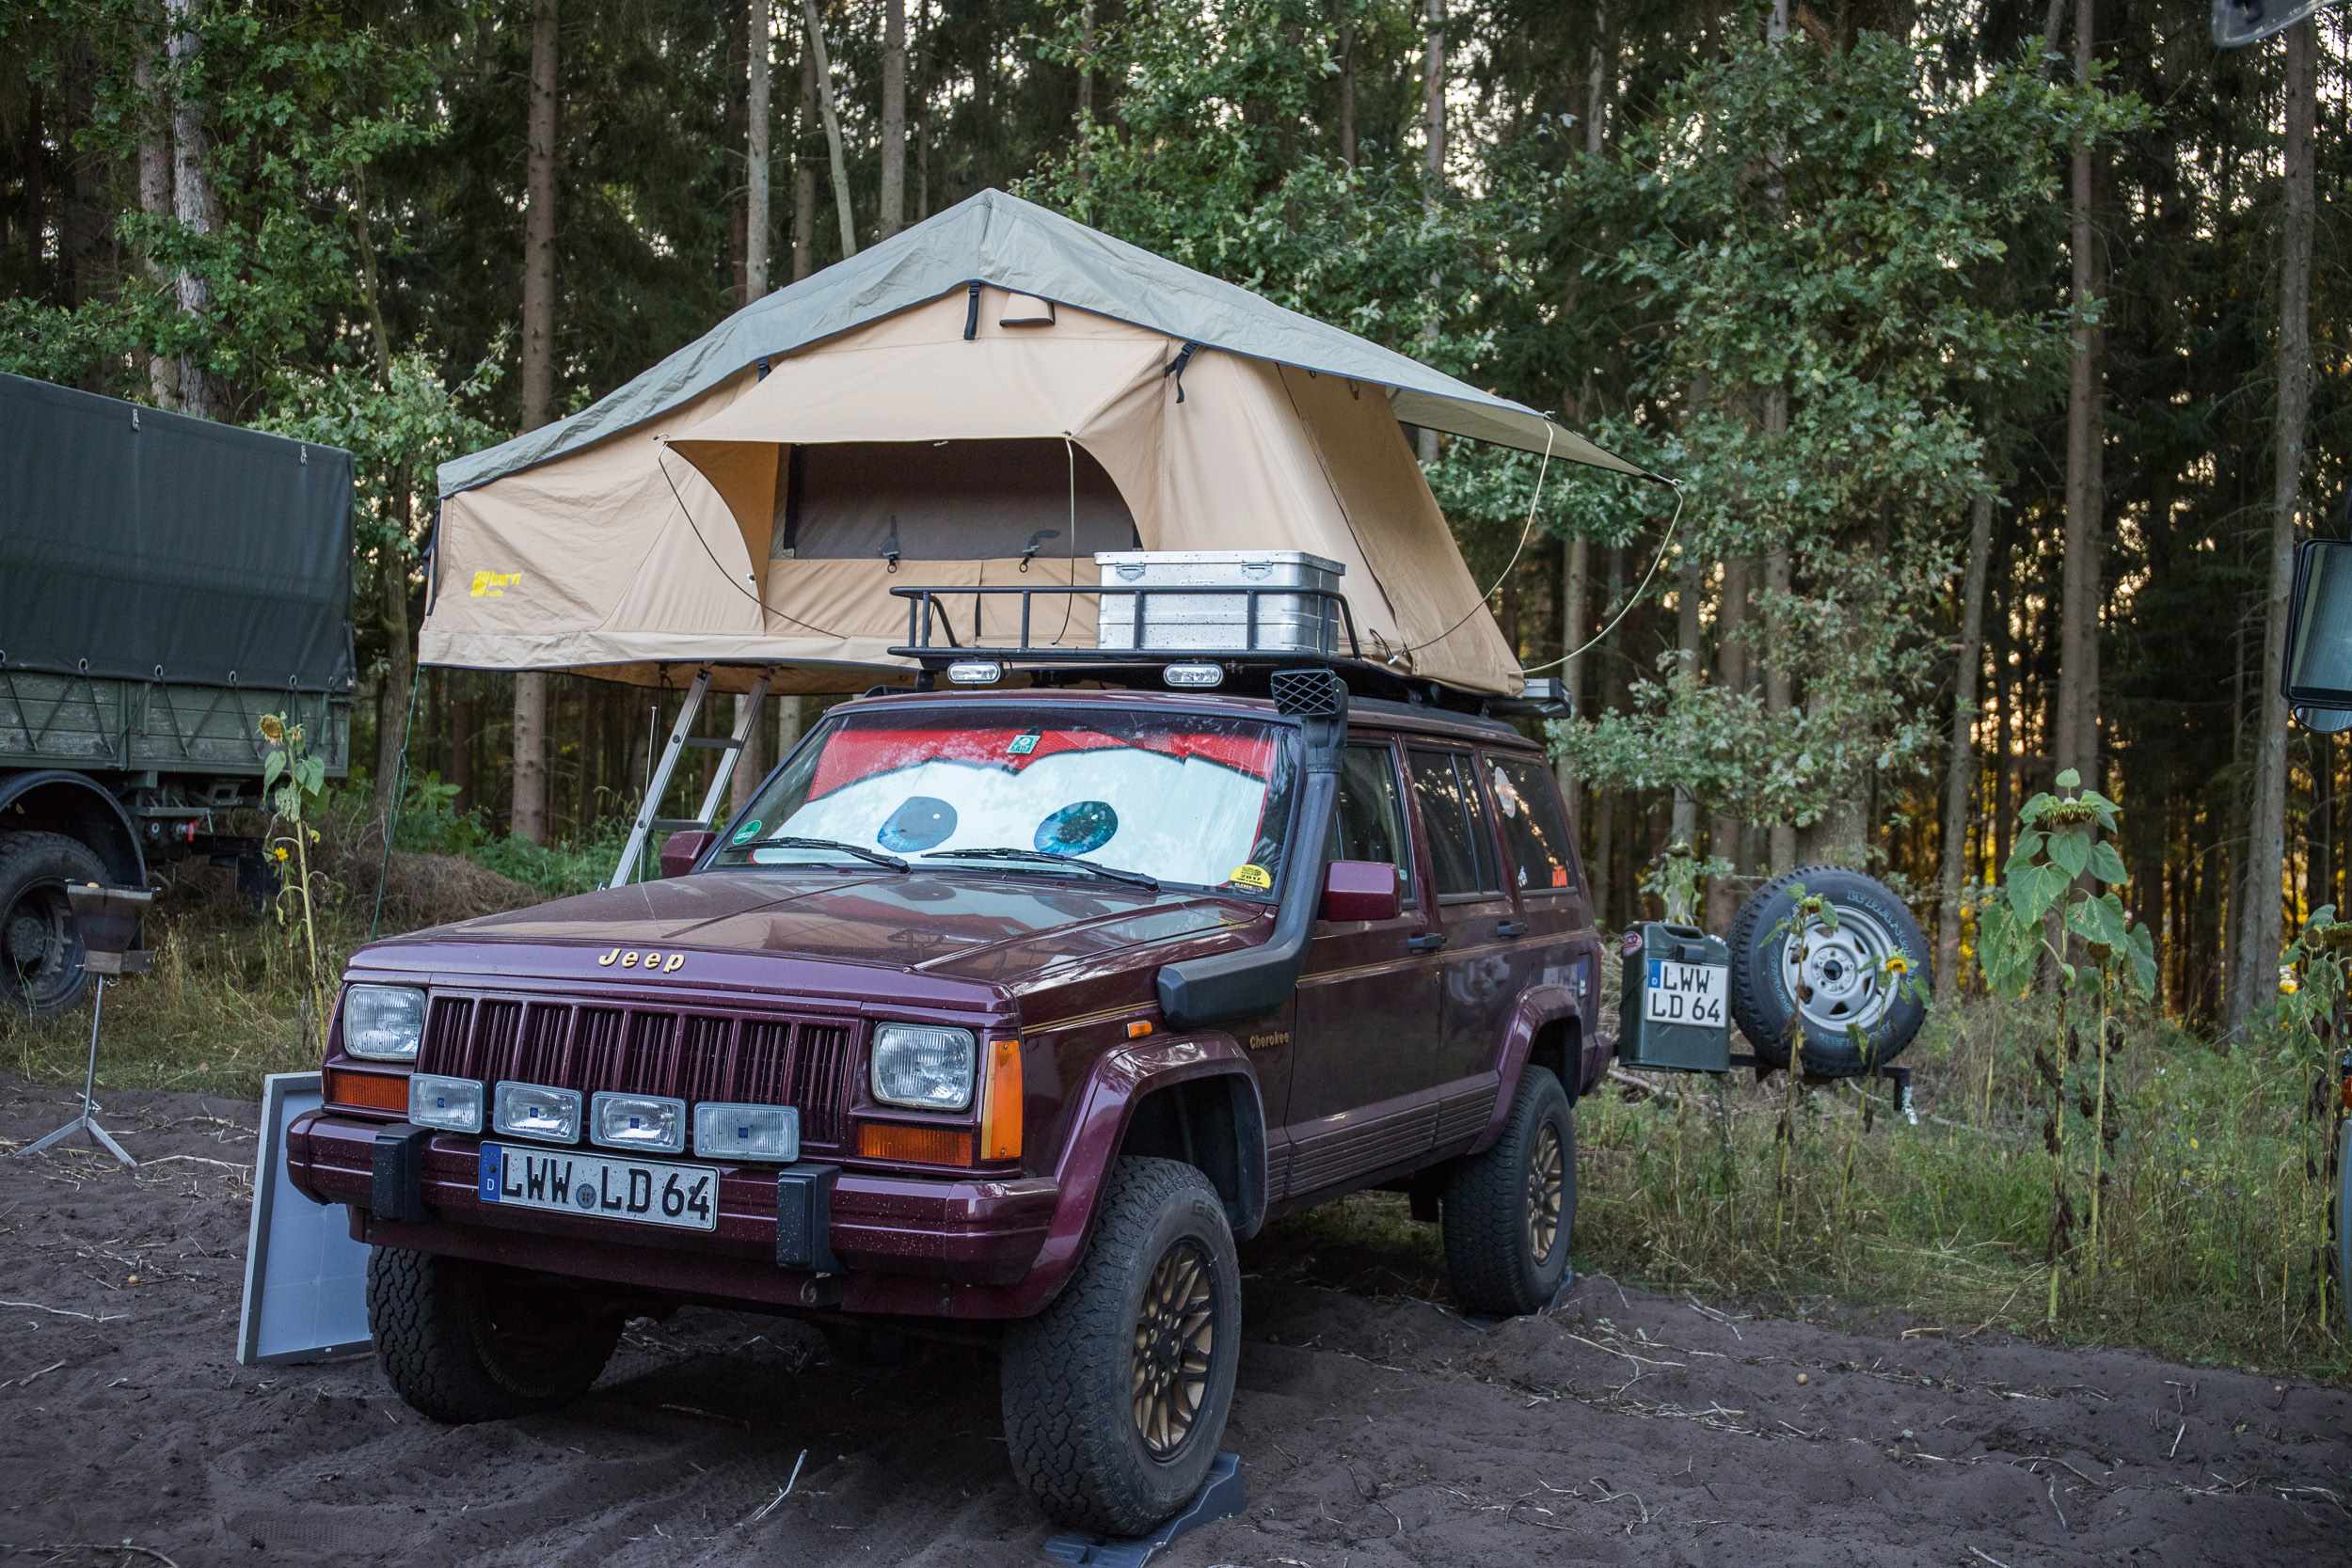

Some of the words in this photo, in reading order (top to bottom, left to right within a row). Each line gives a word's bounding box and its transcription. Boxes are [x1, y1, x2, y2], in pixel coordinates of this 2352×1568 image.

[598, 948, 685, 974] Jeep
[1663, 965, 1710, 993] LWW
[1652, 992, 1683, 1019] LD
[1692, 996, 1721, 1022] 64
[1249, 1031, 1290, 1050] Cherokee
[501, 1152, 573, 1204] LWW
[600, 1165, 652, 1213] LD
[661, 1172, 710, 1221] 64
